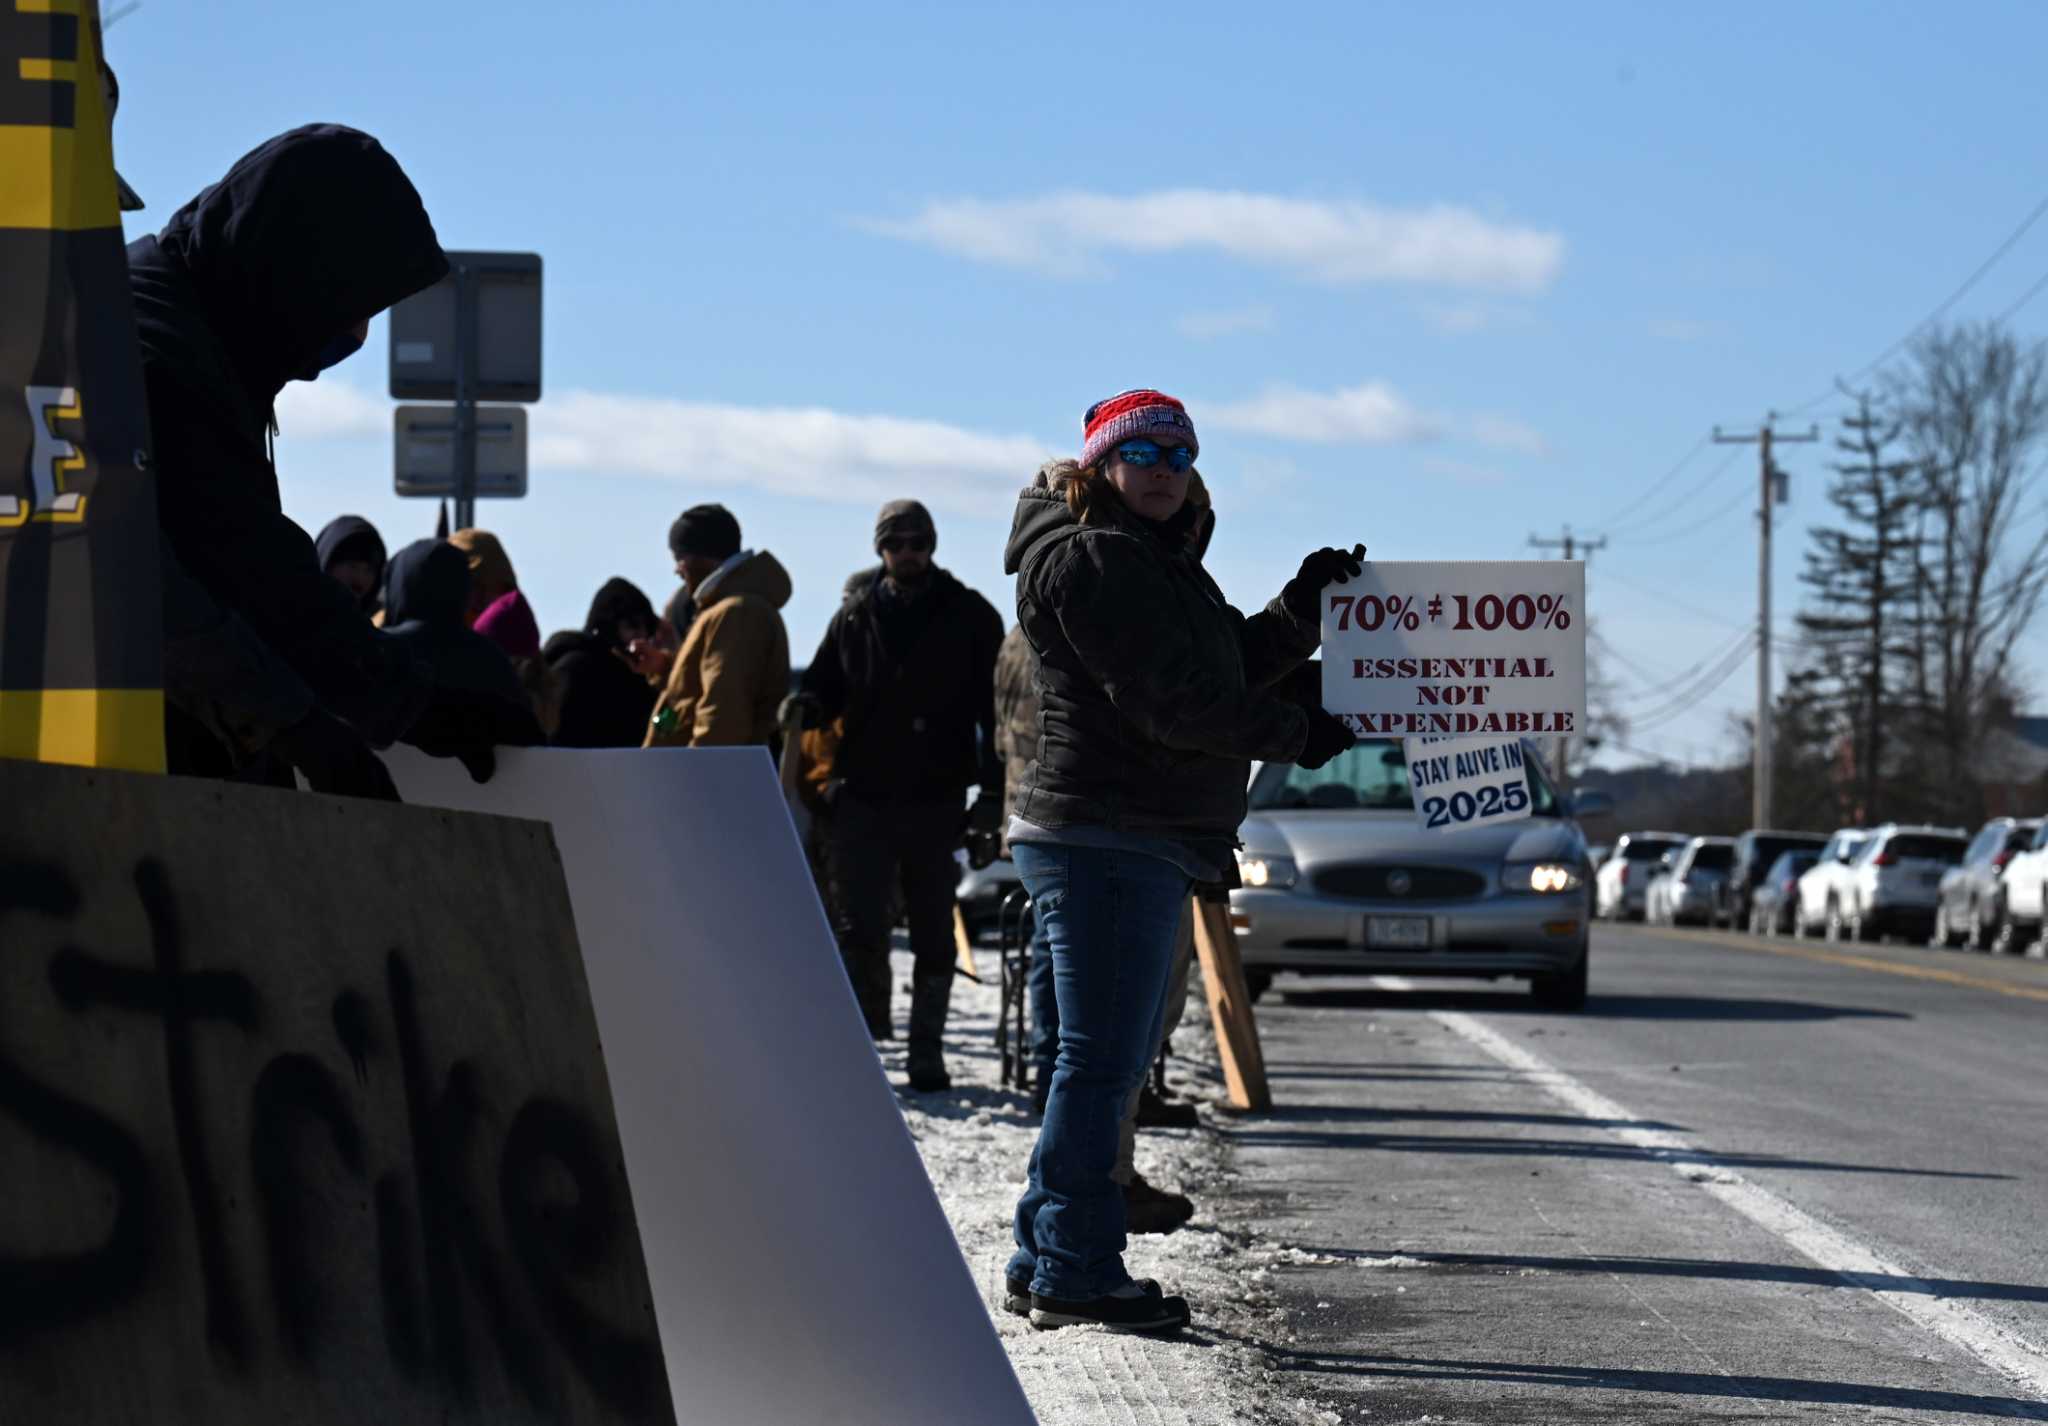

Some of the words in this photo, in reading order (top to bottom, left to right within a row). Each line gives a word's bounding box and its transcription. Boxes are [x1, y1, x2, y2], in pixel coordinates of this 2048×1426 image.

[1330, 595, 1419, 631] 70%
[1452, 594, 1571, 631] 100%
[1352, 658, 1554, 679] ESSENTIAL
[1416, 686, 1490, 706] NOT
[1411, 756, 1451, 788] STAY
[1455, 747, 1500, 780] ALIVE
[1503, 742, 1522, 769] IN
[1422, 780, 1528, 829] 2025
